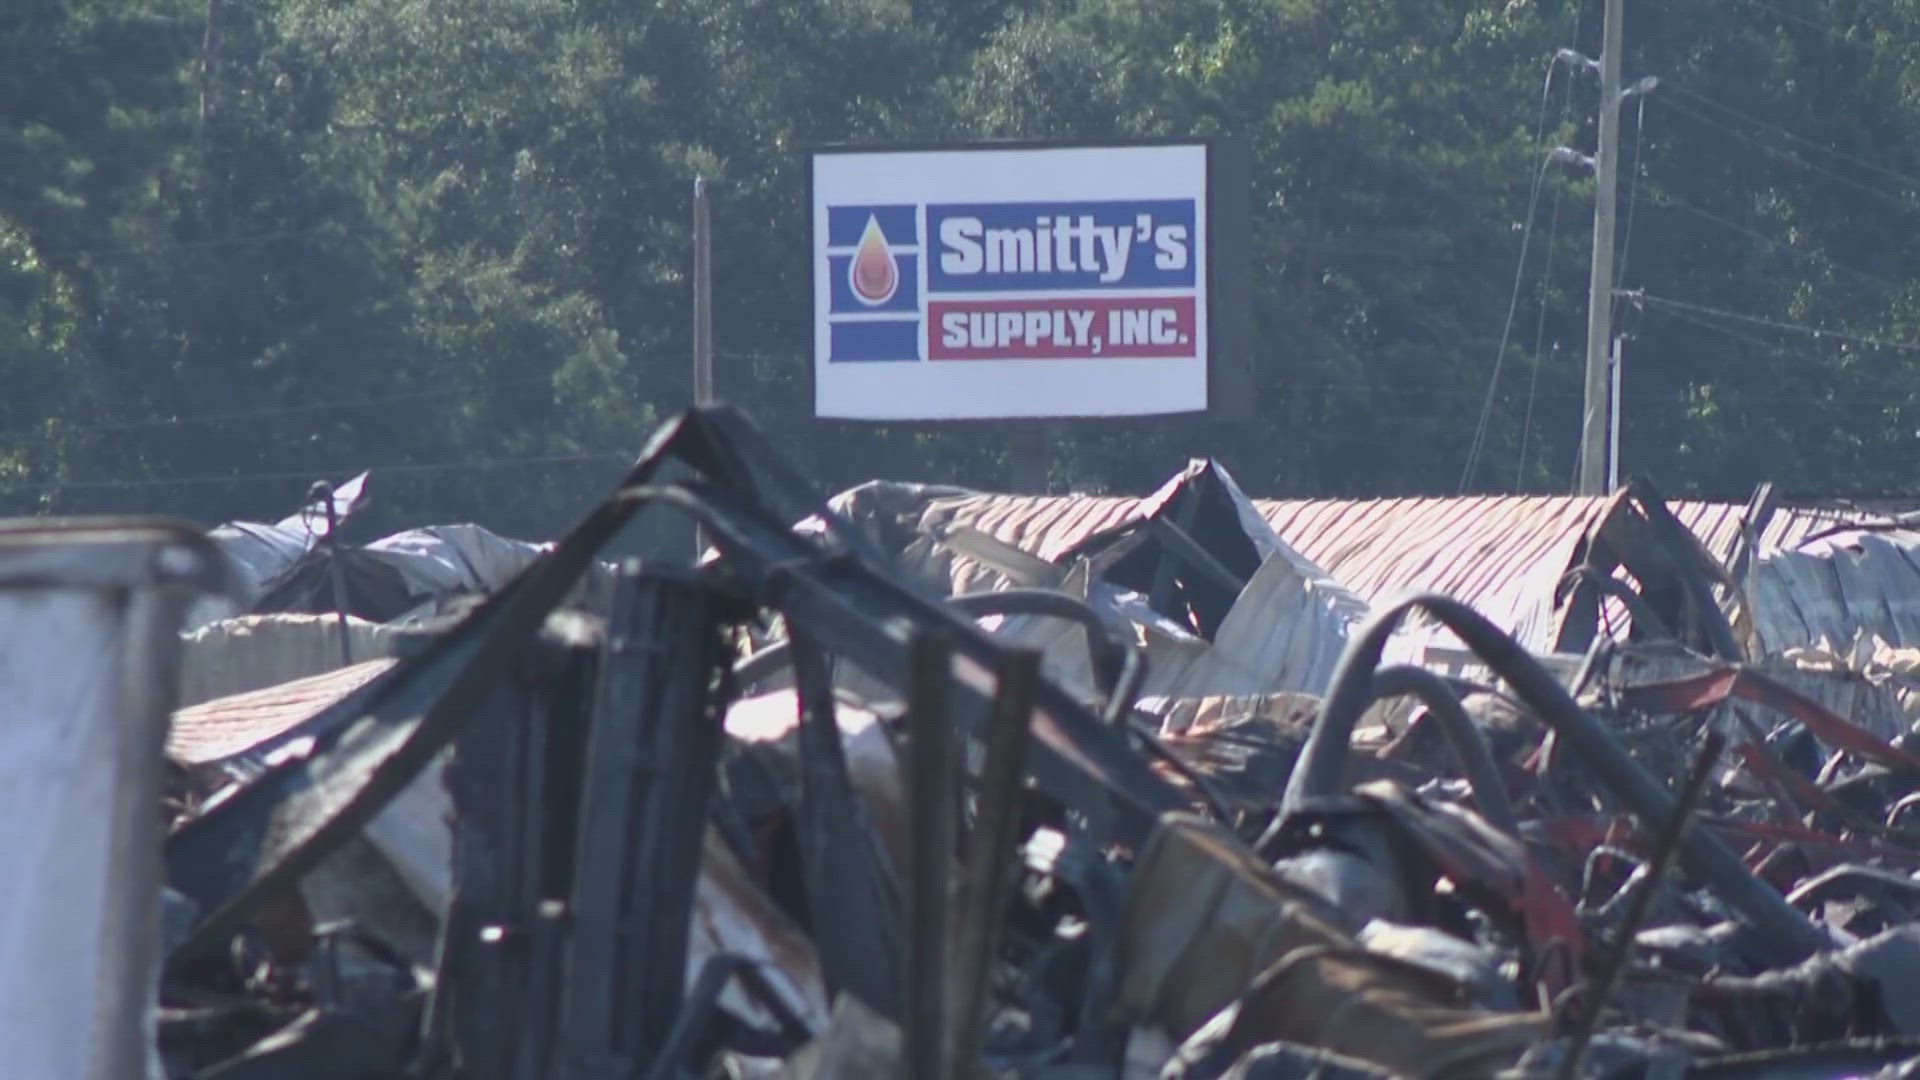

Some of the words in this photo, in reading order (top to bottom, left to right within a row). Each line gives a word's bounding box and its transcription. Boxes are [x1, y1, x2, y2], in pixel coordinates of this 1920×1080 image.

[940, 214, 1188, 282] Smitty's
[942, 309, 1102, 353] SUPPLY,
[1109, 308, 1187, 346] INC.
